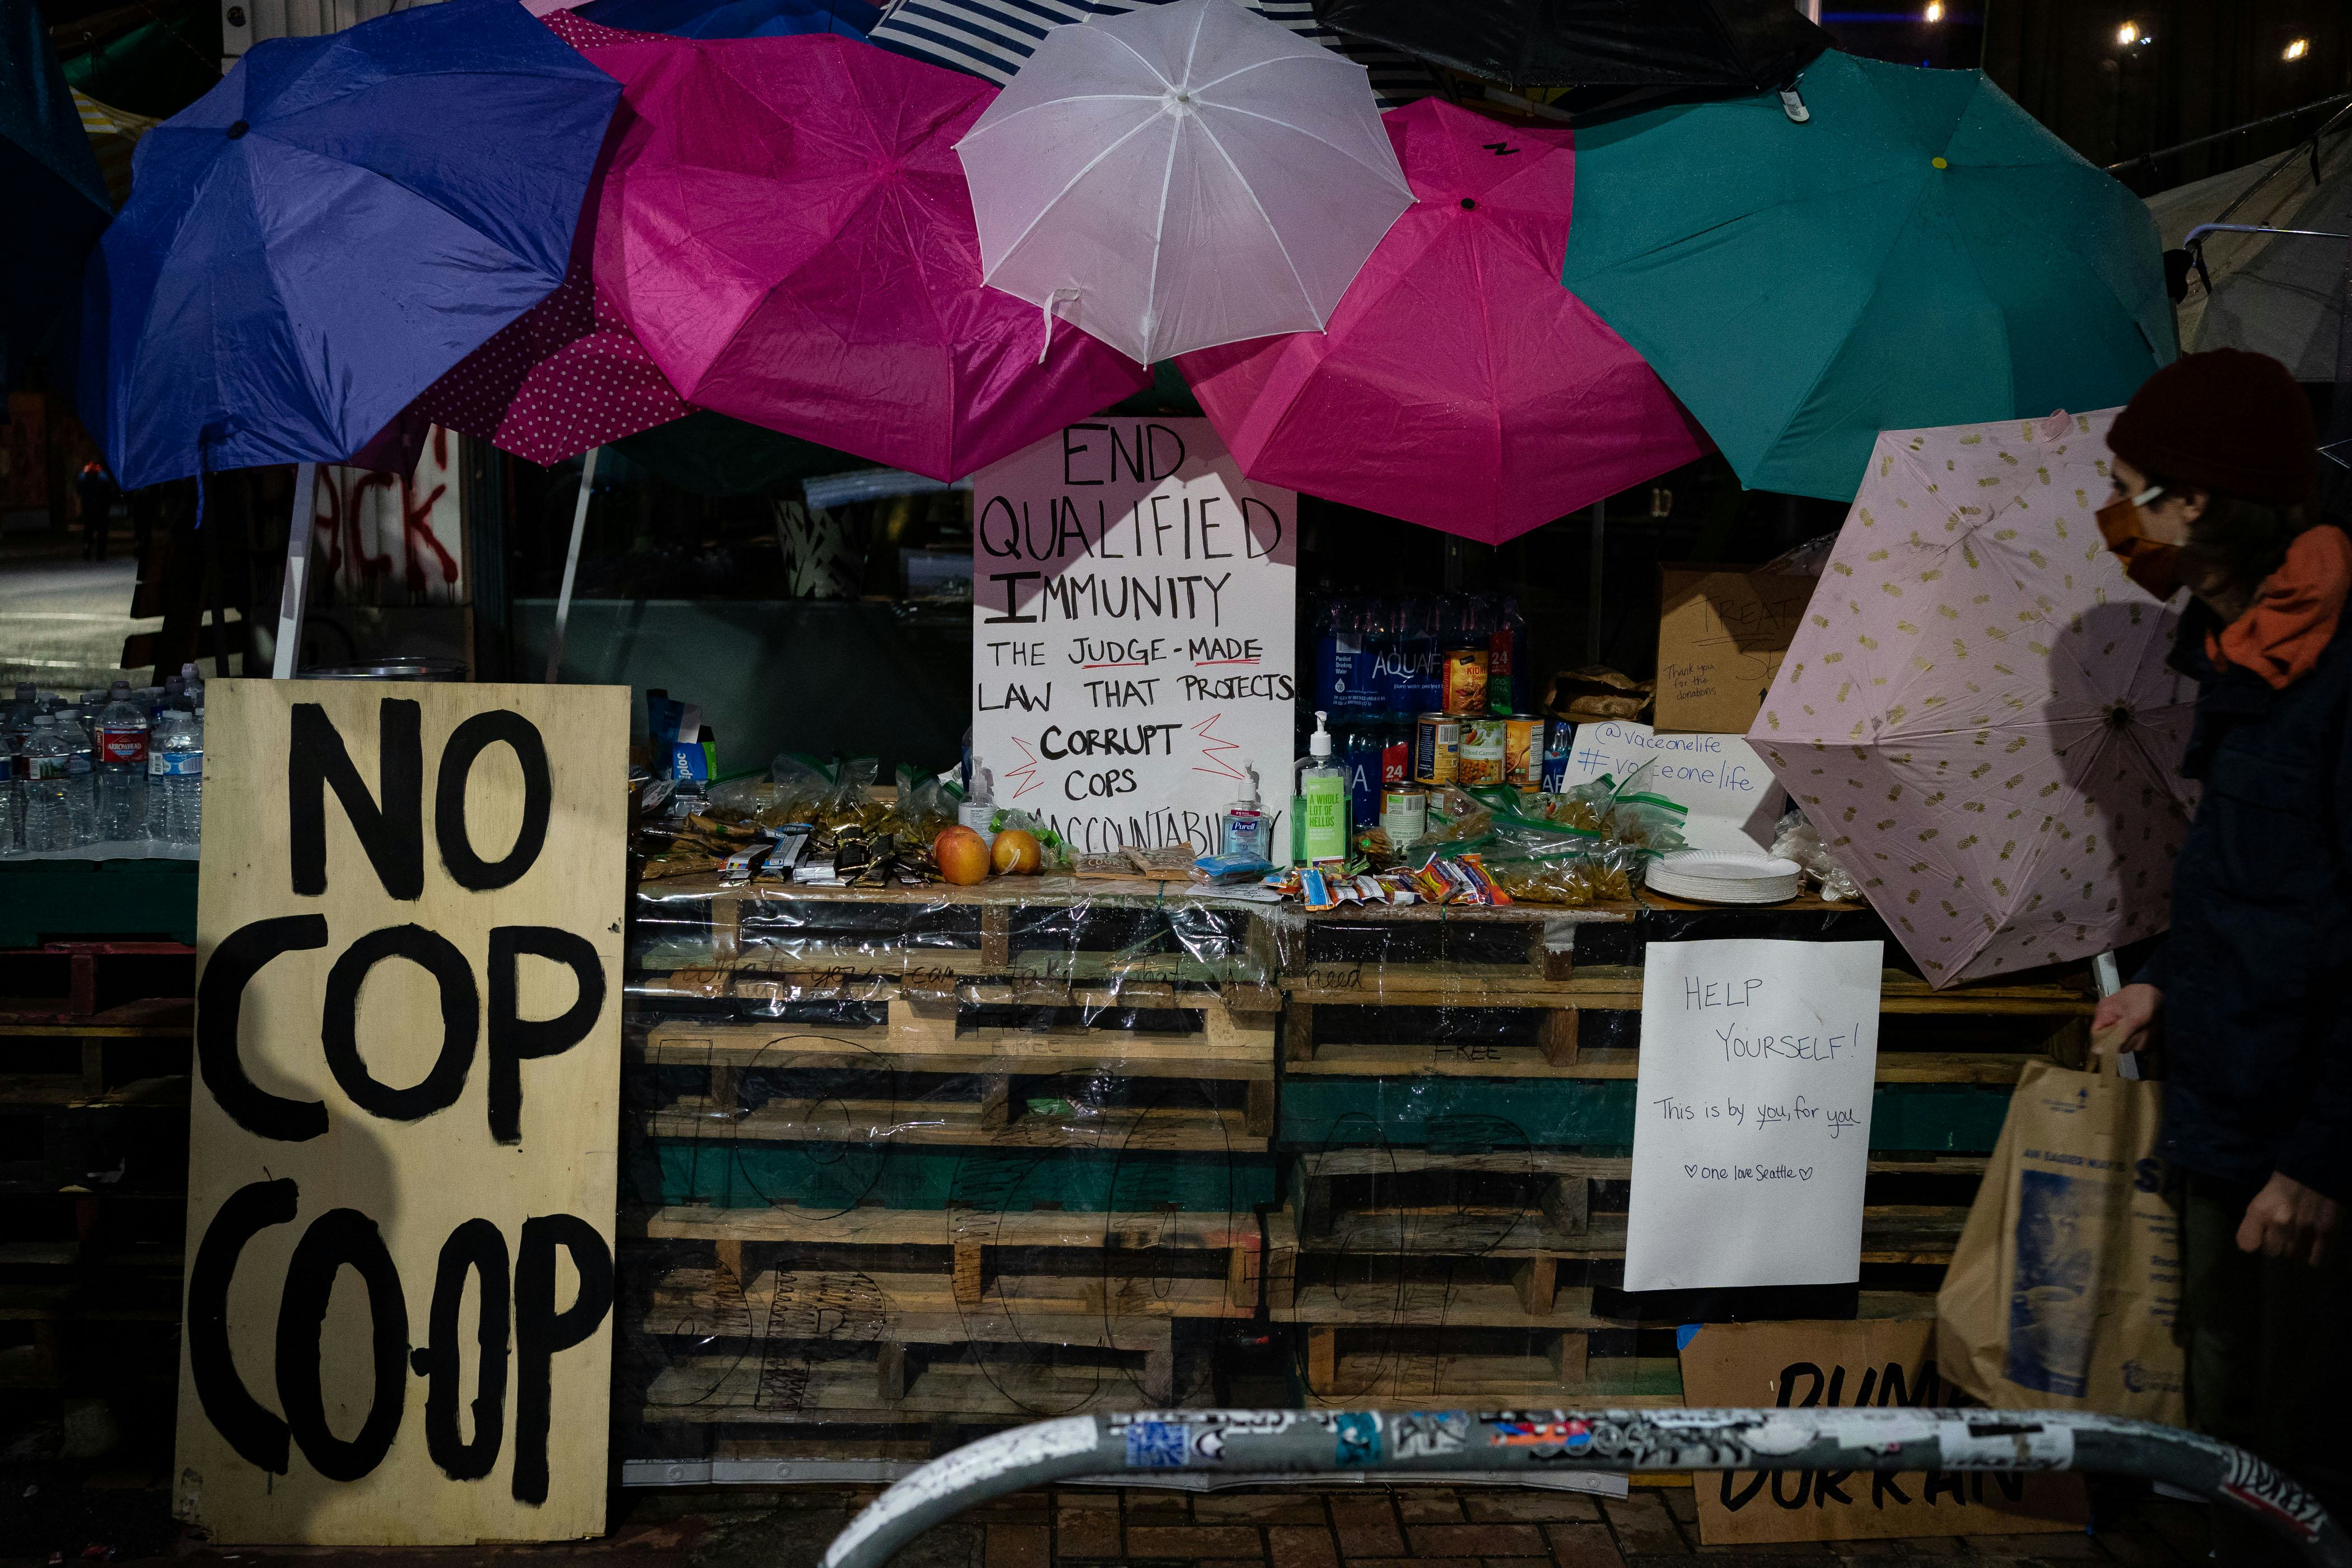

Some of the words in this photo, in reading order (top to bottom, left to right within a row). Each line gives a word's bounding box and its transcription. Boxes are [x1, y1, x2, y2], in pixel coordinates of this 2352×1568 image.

[1063, 423, 1186, 486] END
[980, 494, 1282, 561] QUALIFIED
[984, 571, 1232, 627] IMMUNITY
[986, 641, 1046, 666] THE
[1371, 650, 1444, 679] AQUAF
[1491, 651, 1509, 665] 24
[1466, 666, 1488, 675] KIDNE
[1663, 663, 1693, 680] Thank
[1697, 664, 1716, 677] you
[1672, 678, 1688, 689] for
[1692, 676, 1708, 685] the
[977, 682, 1051, 712] LAW
[1084, 678, 1160, 710] THAT
[1177, 673, 1296, 704] PROTECTS
[1676, 685, 1717, 701] donations
[1039, 723, 1183, 760] CORRUPT
[676, 752, 694, 780] iploc
[1385, 764, 1403, 778] 24
[1578, 748, 1754, 791] #voceonelife
[1064, 768, 1137, 801] COPS
[289, 698, 554, 901] NO
[1309, 794, 1314, 805] A
[1316, 793, 1340, 805] WHOLE
[1309, 805, 1322, 816] LOT
[1324, 805, 1333, 816] OF
[1234, 822, 1256, 830] Purell
[1309, 816, 1335, 827] HELLOS
[1306, 961, 1366, 989] need
[1684, 976, 1763, 1010] HELP
[197, 913, 607, 1146] COP
[1715, 1023, 1859, 1061] YOURSELF!
[1434, 1039, 1502, 1062] FREE
[1653, 1096, 1695, 1119] This
[1705, 1102, 1720, 1118] is
[1728, 1098, 1745, 1126] by
[1794, 1095, 1817, 1119] for
[1826, 1109, 1860, 1139] you
[1701, 1166, 1729, 1179] one
[1734, 1164, 1753, 1179] love
[1756, 1164, 1798, 1181] Seattle
[188, 1176, 615, 1506] CO-OP
